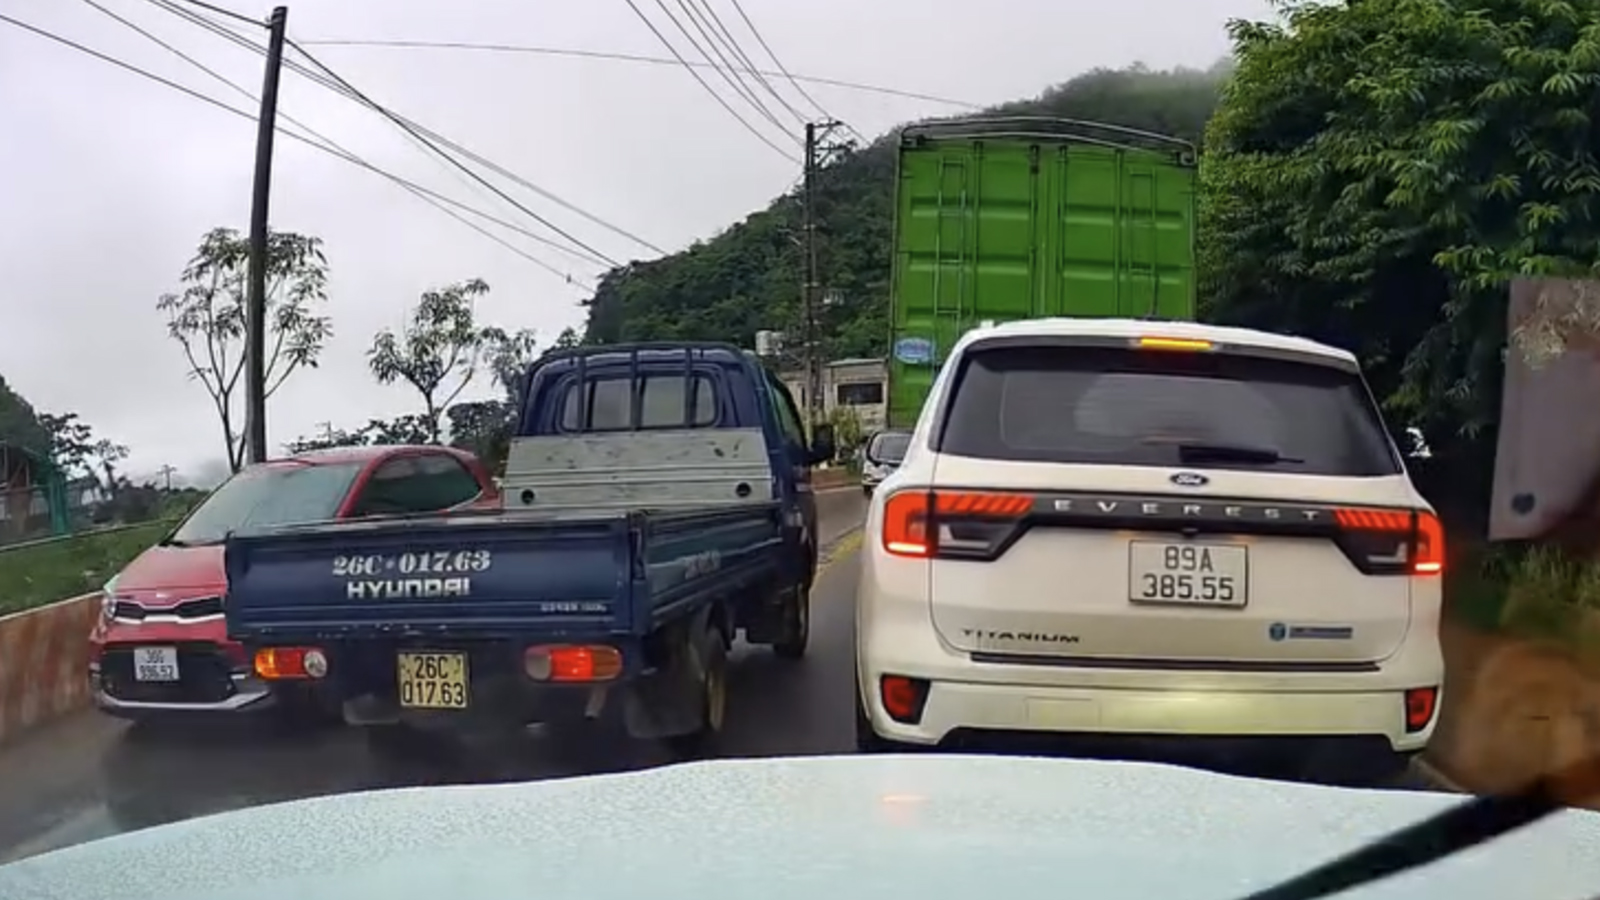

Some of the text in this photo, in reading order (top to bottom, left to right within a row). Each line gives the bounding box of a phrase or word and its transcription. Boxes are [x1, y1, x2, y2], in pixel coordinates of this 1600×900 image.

[1054, 499, 1319, 521] EVEREST
[398, 549, 491, 574] 017.63
[1164, 545, 1214, 572] 89A
[347, 577, 470, 598] HYUNDAI
[1143, 573, 1234, 601] 385.55
[961, 629, 1080, 643] TITANIUM
[413, 655, 449, 679] 26C
[402, 680, 464, 705] 017.63
